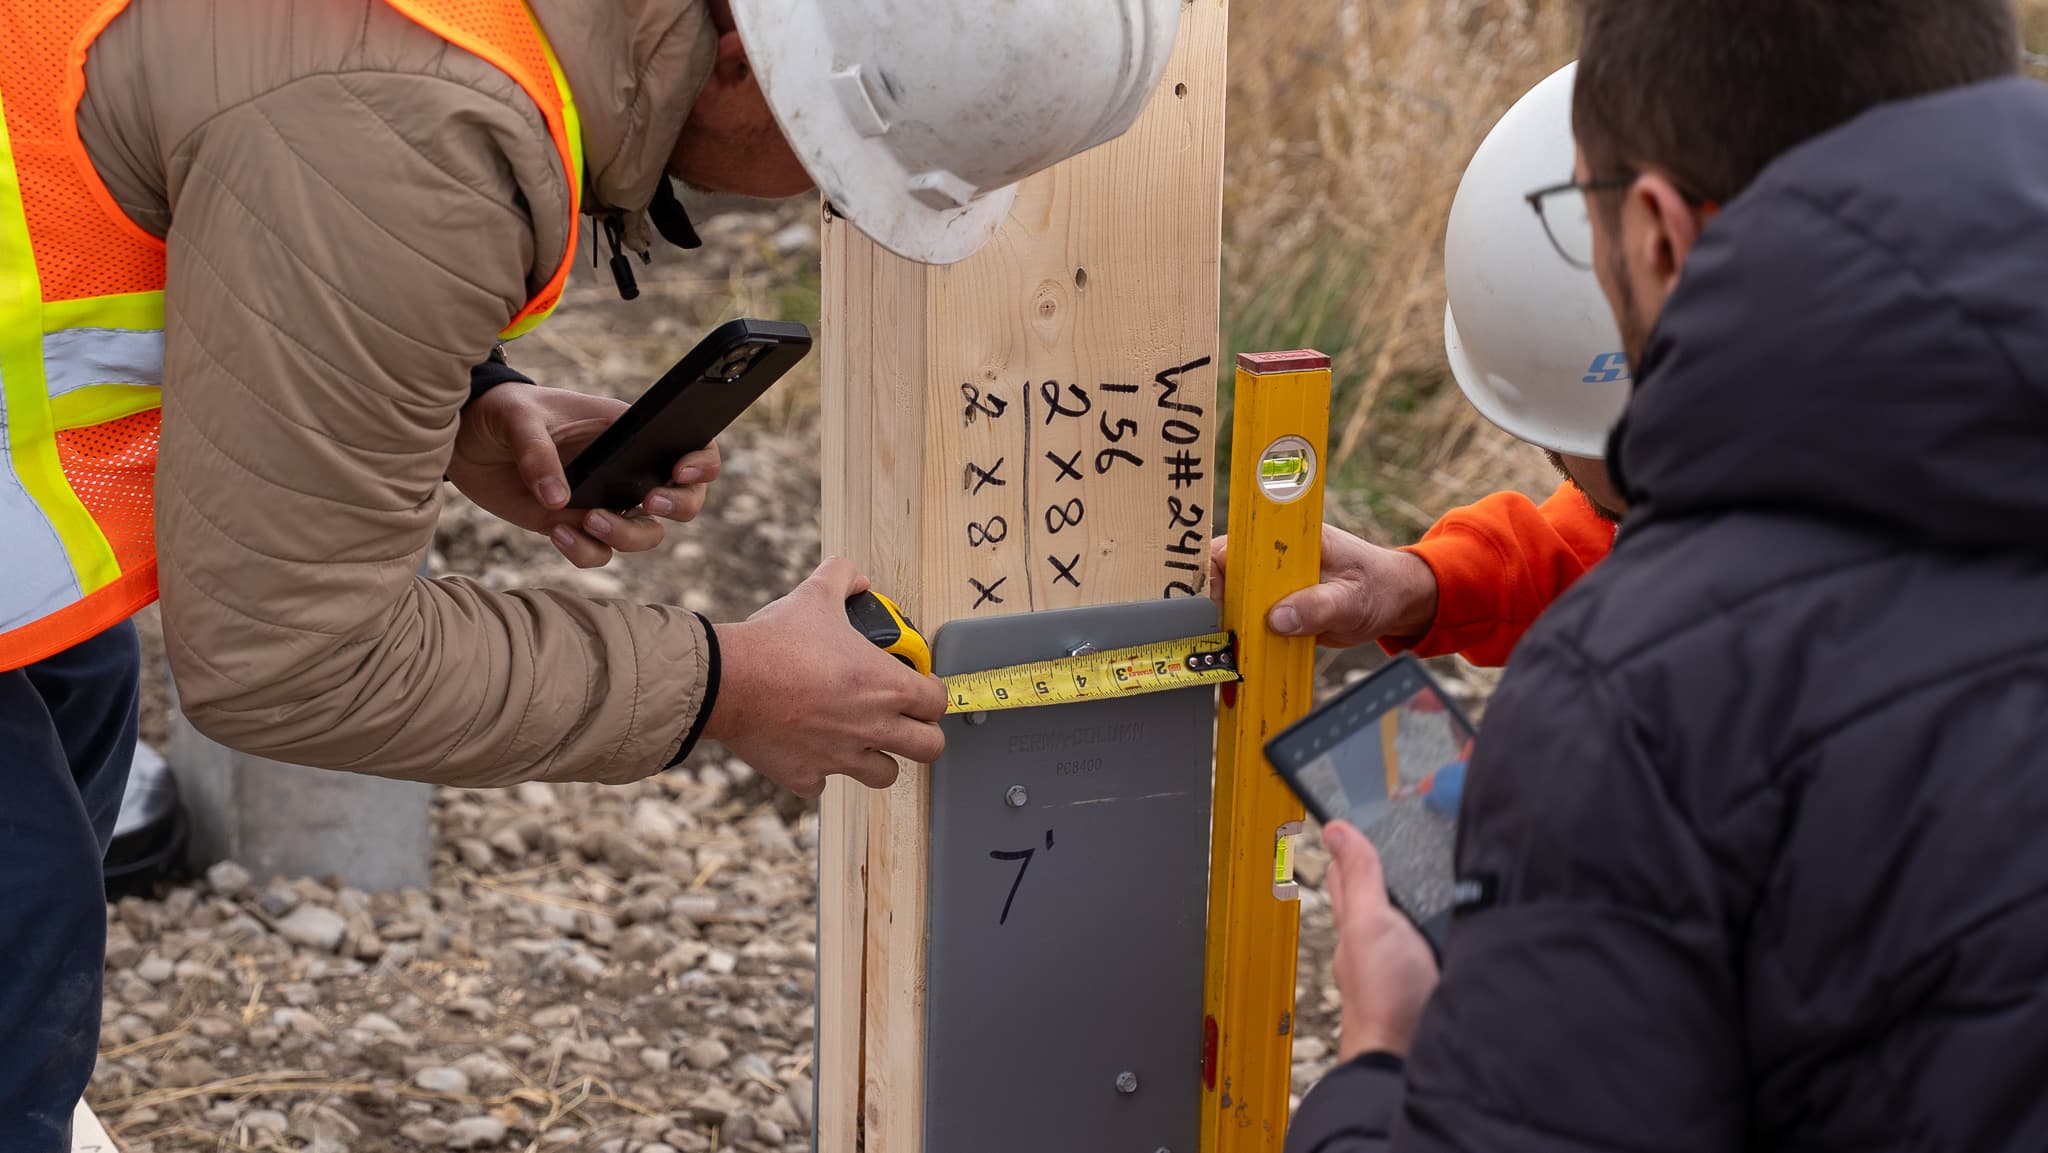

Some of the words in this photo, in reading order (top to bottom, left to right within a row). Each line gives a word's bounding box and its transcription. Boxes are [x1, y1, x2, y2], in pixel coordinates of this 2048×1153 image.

[1095, 383, 1144, 474] 156
[1116, 667, 1128, 681] 3
[1155, 661, 1167, 675] 2
[1035, 681, 1050, 694] 5
[1076, 675, 1087, 688] 4
[957, 694, 969, 706] 7
[995, 687, 1009, 700] 6
